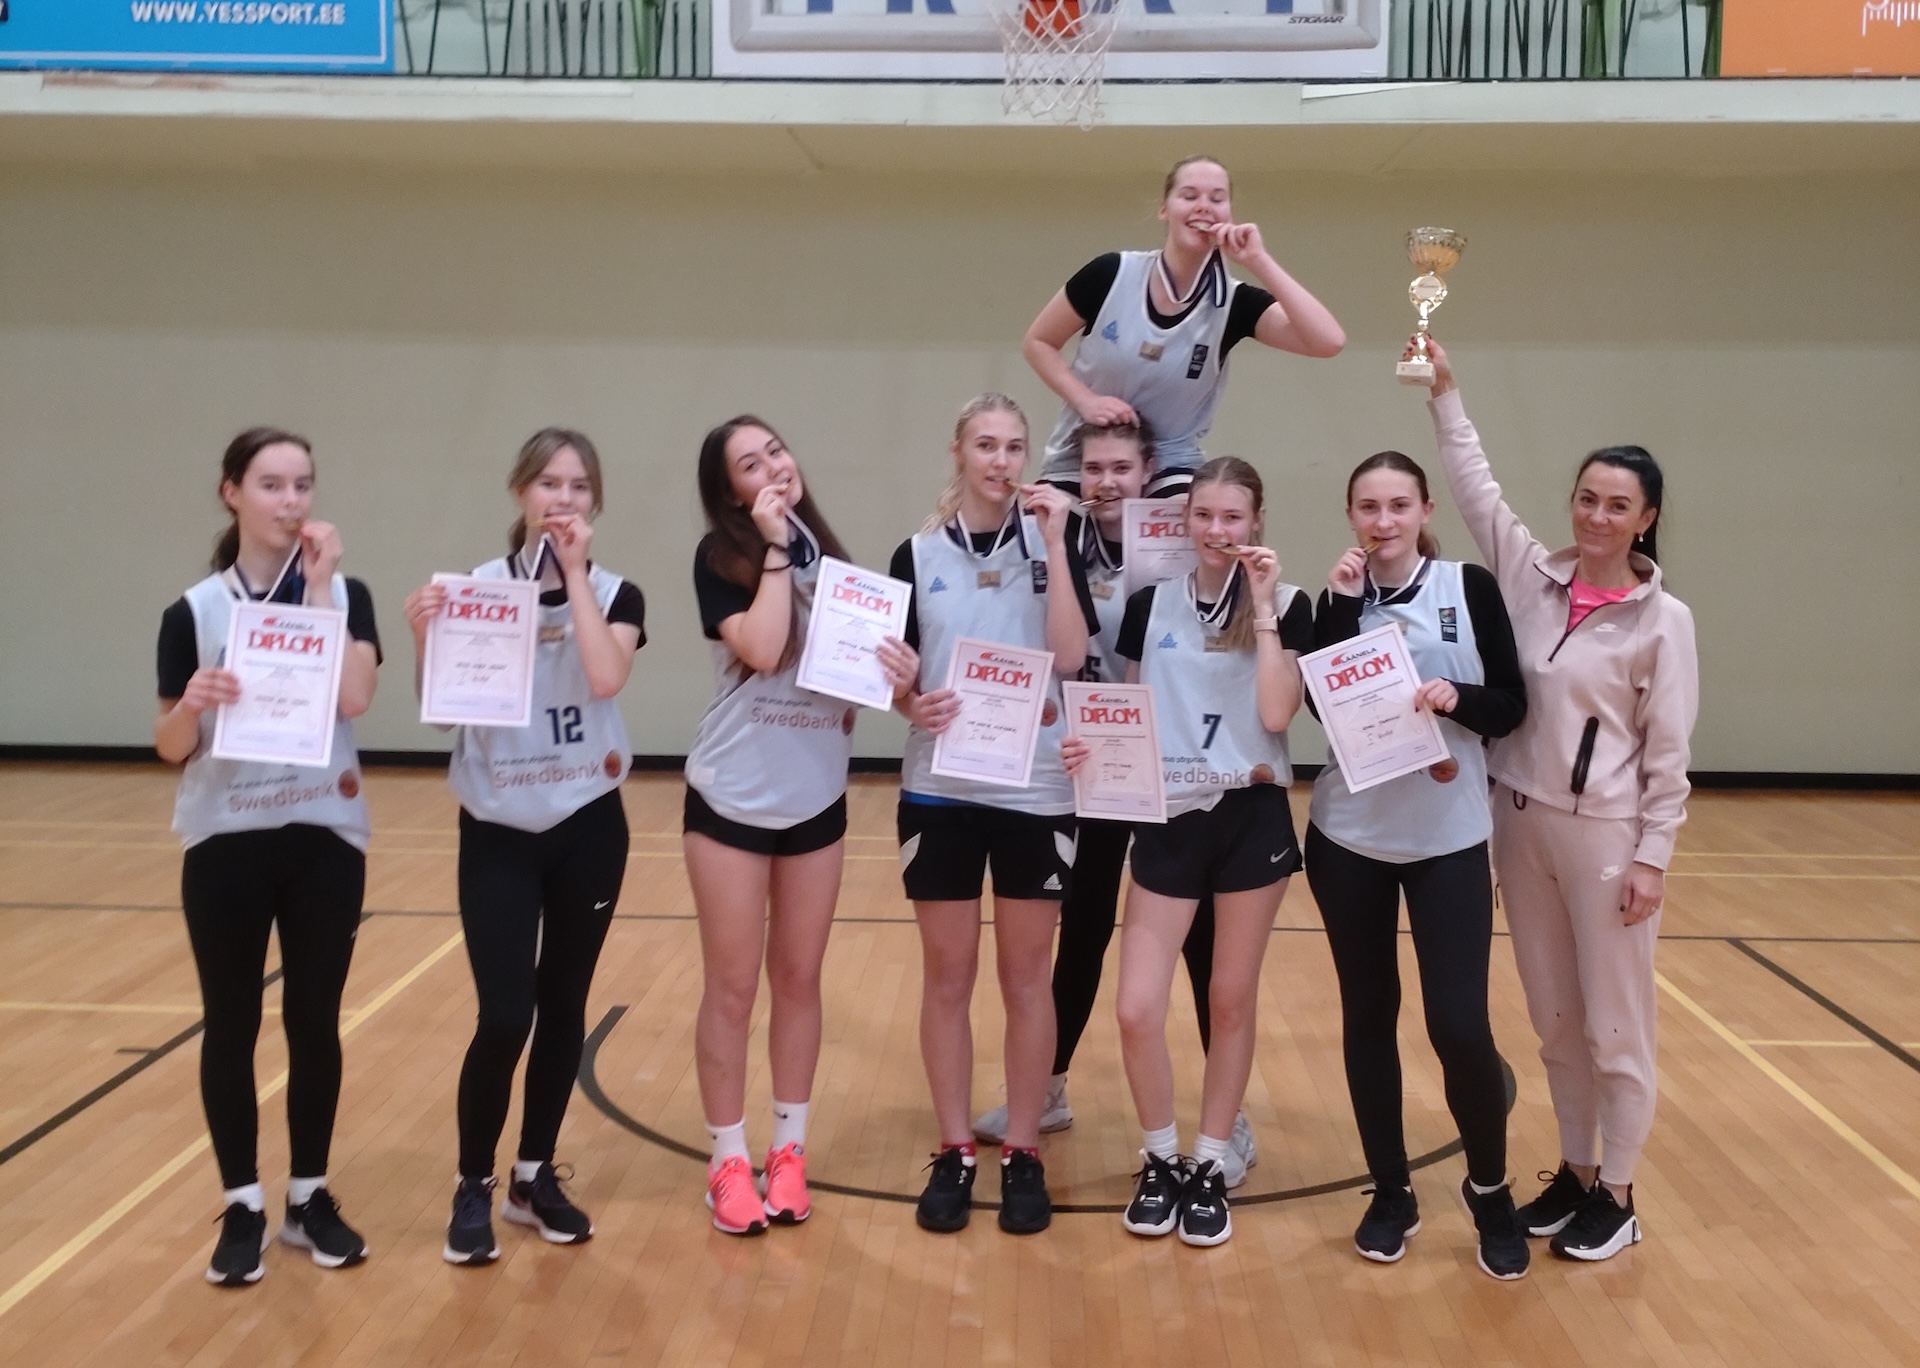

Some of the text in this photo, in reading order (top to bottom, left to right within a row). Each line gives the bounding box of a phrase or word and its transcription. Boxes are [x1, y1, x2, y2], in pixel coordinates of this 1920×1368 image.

[131, 1, 345, 25] WWW.YESSPORT.EE
[1288, 15, 1344, 24] STIGMAR
[1138, 522, 1190, 538] DIPLO
[446, 601, 520, 623] DIPLOM
[831, 583, 893, 616] DIPLOM
[247, 630, 325, 656] DIPLOM
[965, 662, 1033, 689] DIPLOM
[1324, 652, 1396, 692] DIPLOM
[546, 705, 584, 745] 12
[751, 706, 840, 730] Swedbank
[1079, 706, 1142, 725] DIPLOM
[1201, 713, 1222, 749] 7
[495, 761, 600, 788] Swedbank
[1162, 767, 1245, 786] wedbank
[229, 781, 334, 814] Swedbank
